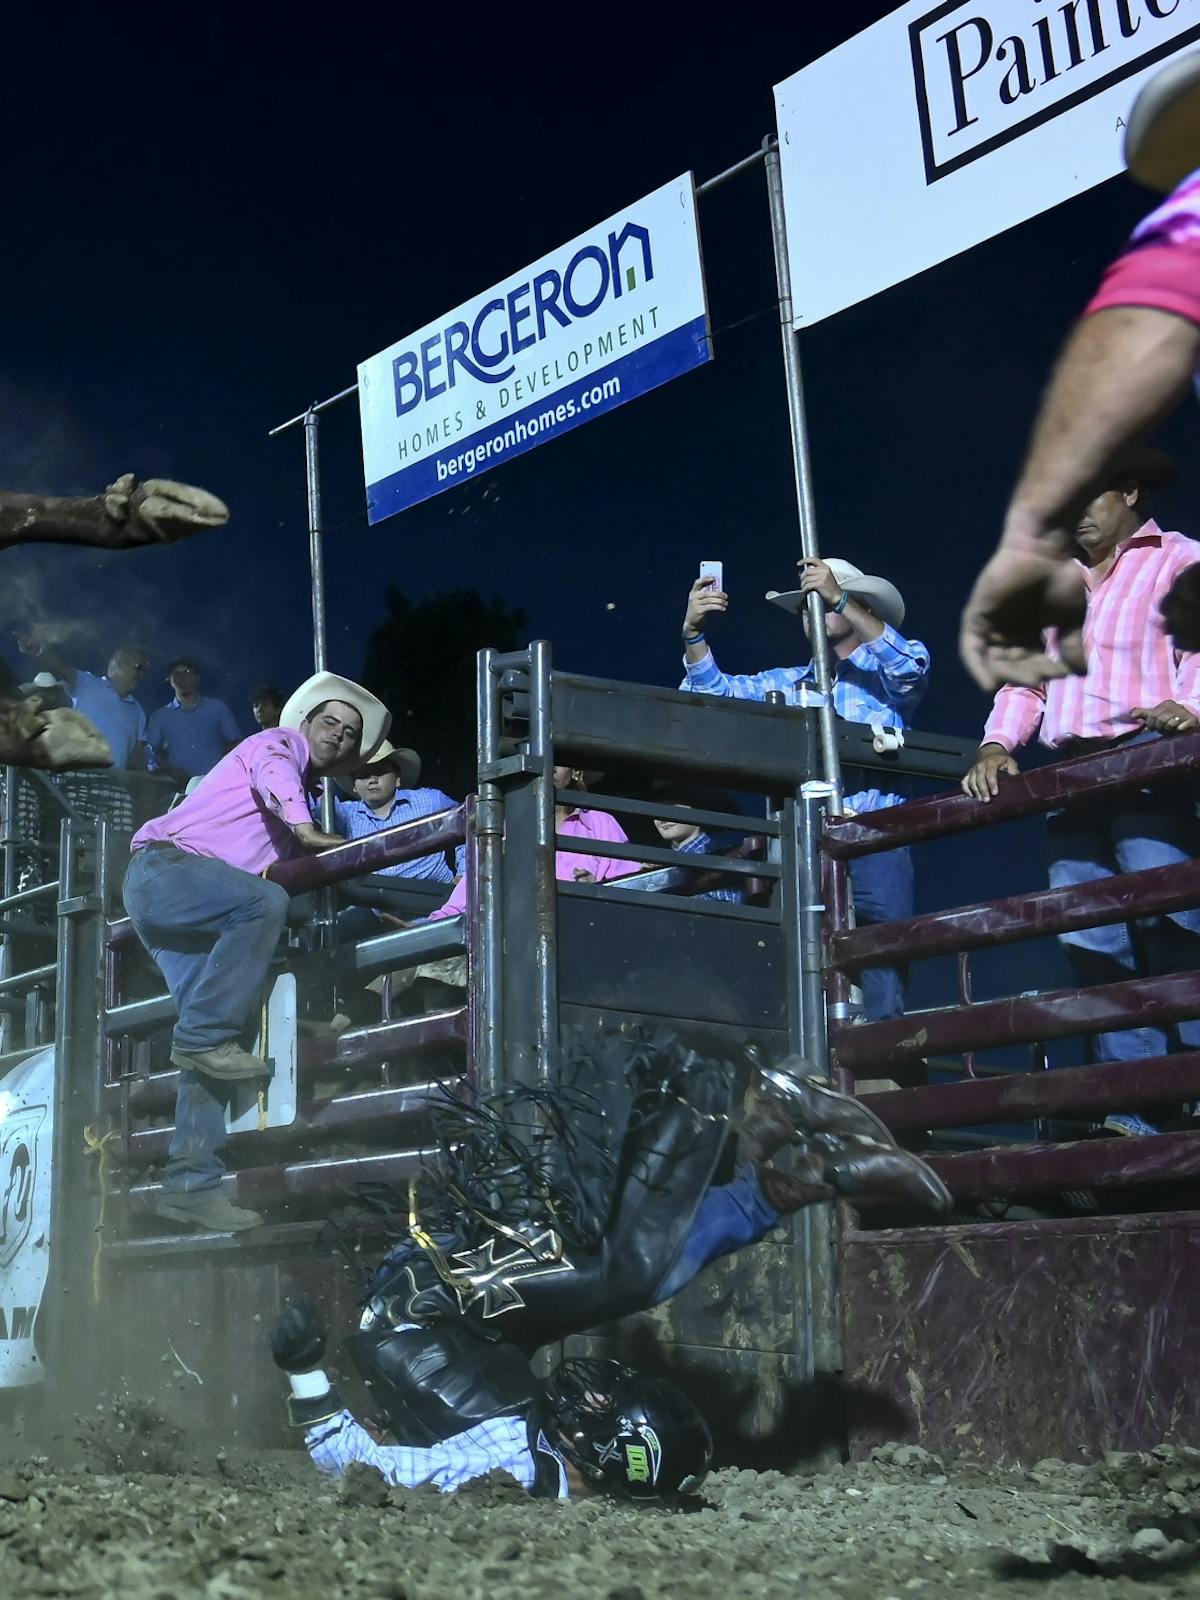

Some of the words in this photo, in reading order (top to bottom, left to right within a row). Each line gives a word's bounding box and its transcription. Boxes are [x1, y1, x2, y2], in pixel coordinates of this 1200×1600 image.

[398, 411, 464, 460] HOMES
[476, 400, 487, 420] &
[499, 306, 659, 409] DEVELOPMENT
[437, 376, 621, 481] bergeronhomes.com
